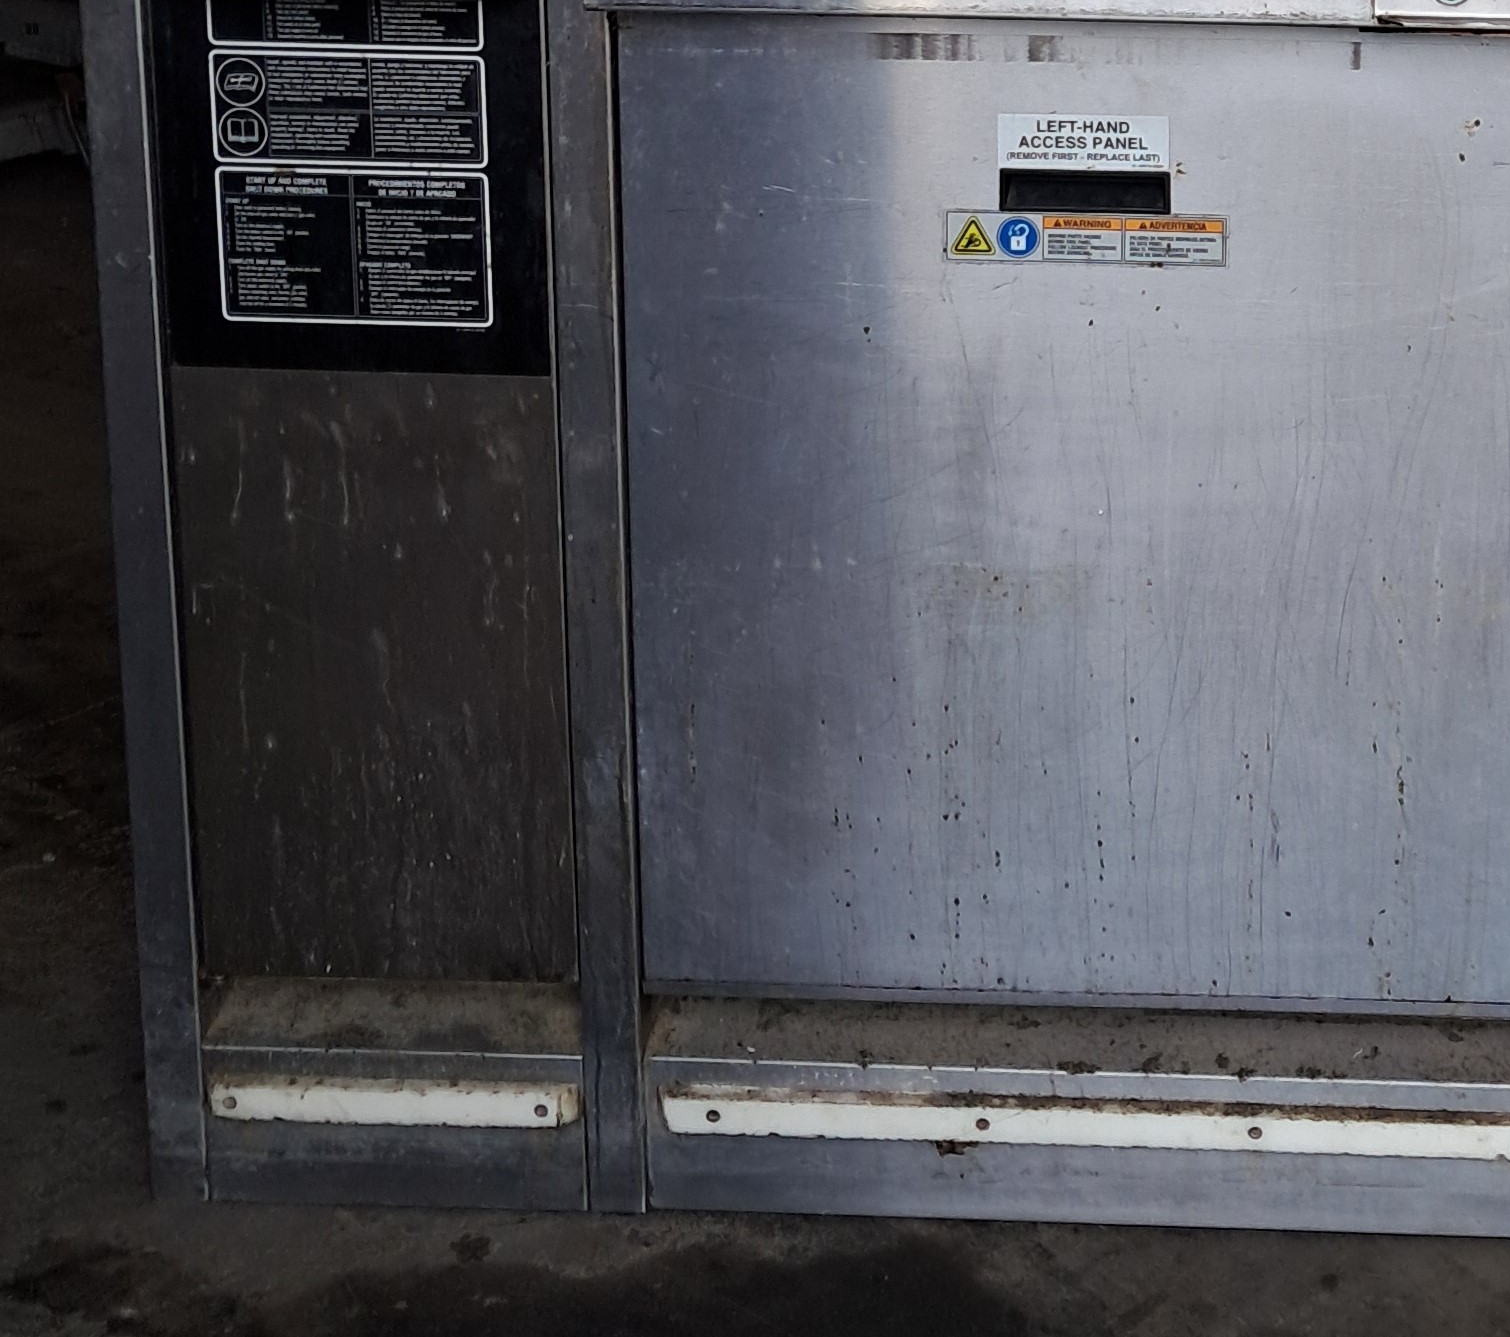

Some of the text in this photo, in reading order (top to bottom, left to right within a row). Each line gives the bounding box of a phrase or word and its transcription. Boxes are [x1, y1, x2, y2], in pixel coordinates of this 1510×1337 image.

[1036, 120, 1130, 134] LEFT-HAND
[1018, 136, 1148, 150] ACCESS PANEL
[1006, 152, 1049, 161] (REMOVE
[1052, 152, 1078, 161] FIRST
[1087, 153, 1130, 162] REPLACE
[1133, 154, 1160, 163] LAST)
[1063, 220, 1112, 229] WARNING
[1149, 221, 1207, 231] ADVERTENCIA
